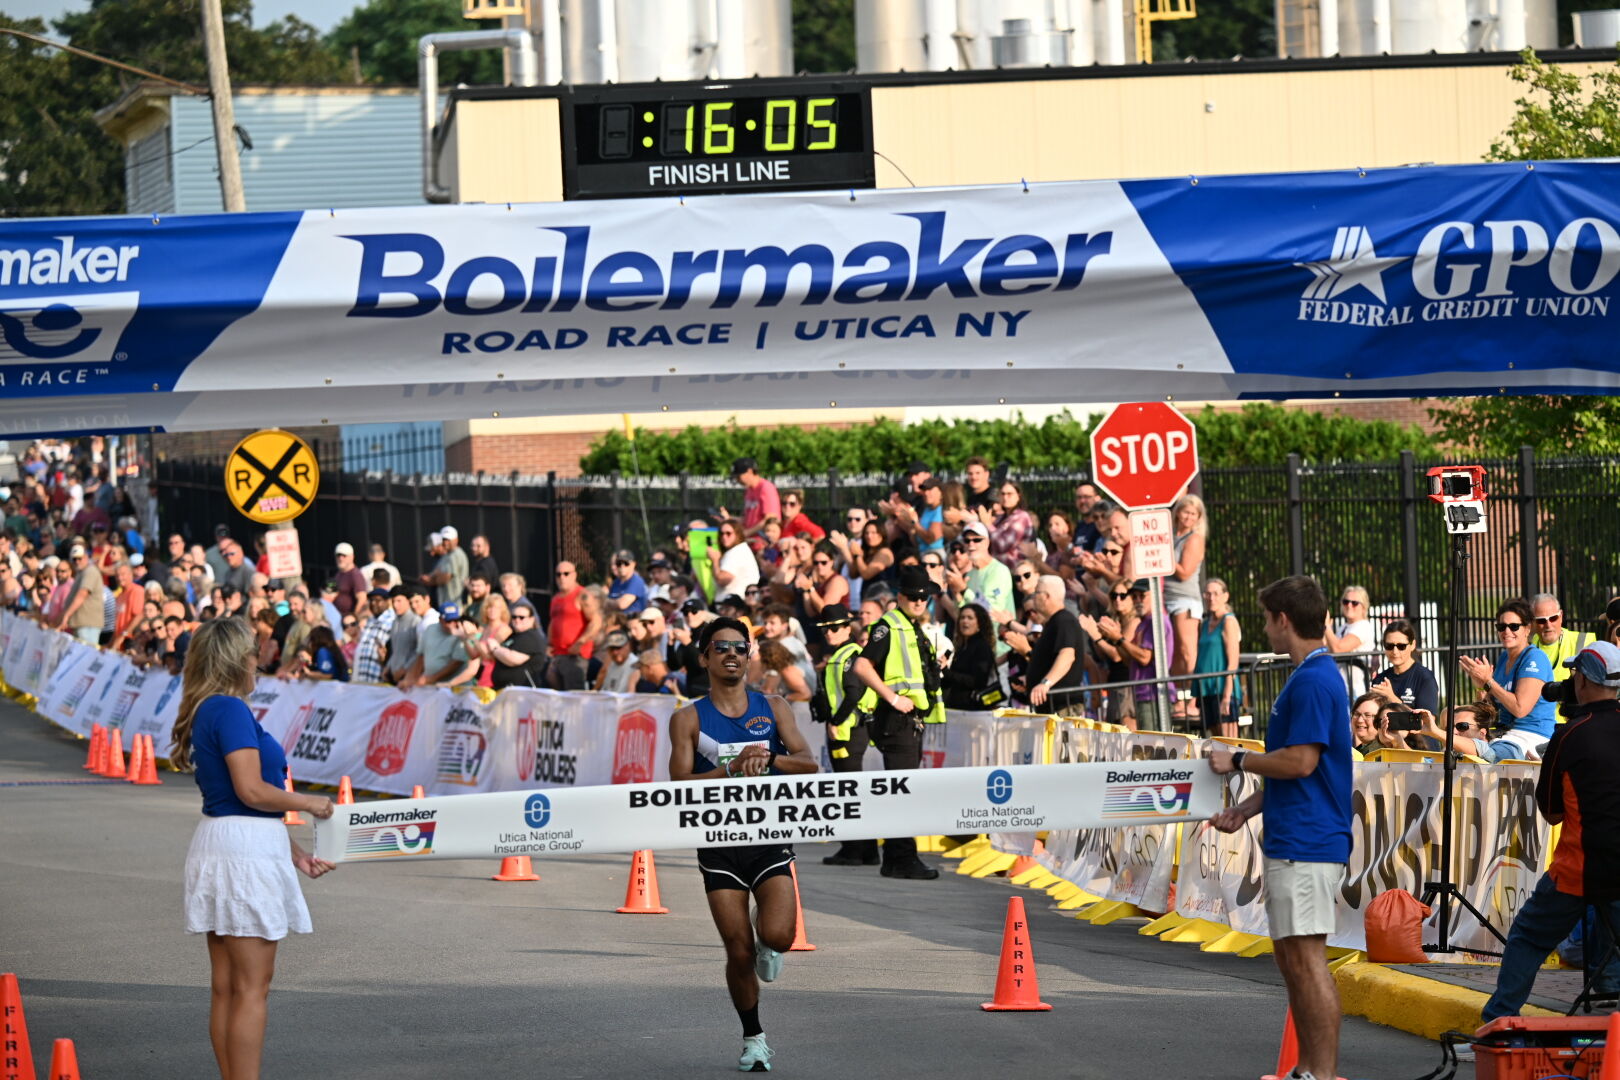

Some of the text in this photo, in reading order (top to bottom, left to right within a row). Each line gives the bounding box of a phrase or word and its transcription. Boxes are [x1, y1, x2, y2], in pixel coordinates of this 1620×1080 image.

[649, 160, 790, 185] FINISH LINE
[334, 211, 1113, 318] Boilermaker
[1411, 217, 1620, 301] GPO
[1298, 296, 1610, 327] FEDERAL CREDIT UNION
[441, 328, 588, 355] ROAD
[607, 323, 733, 347] RACE
[795, 314, 936, 341] UTICA
[955, 310, 1032, 337] NY
[21, 368, 88, 386] RACE
[1101, 430, 1189, 477] STOP
[234, 463, 311, 490] R R
[1142, 518, 1158, 530] NO
[1134, 533, 1169, 546] PARKING
[1144, 560, 1163, 569] TIME
[1145, 549, 1160, 558] ANY
[537, 718, 564, 750] UTICA
[534, 753, 577, 785] BOILERS
[1106, 769, 1193, 783] Boilermaker
[629, 776, 911, 808] BOILERMAKER 5K
[349, 808, 437, 826] Boilermaker
[679, 802, 861, 828] ROAD RACE
[961, 805, 1035, 818] Utica National
[705, 824, 835, 843] Utica, New York
[956, 818, 1008, 830] Insurance
[499, 828, 573, 843] Utica National
[494, 841, 546, 854] Insurance
[637, 849, 646, 896] LRRT
